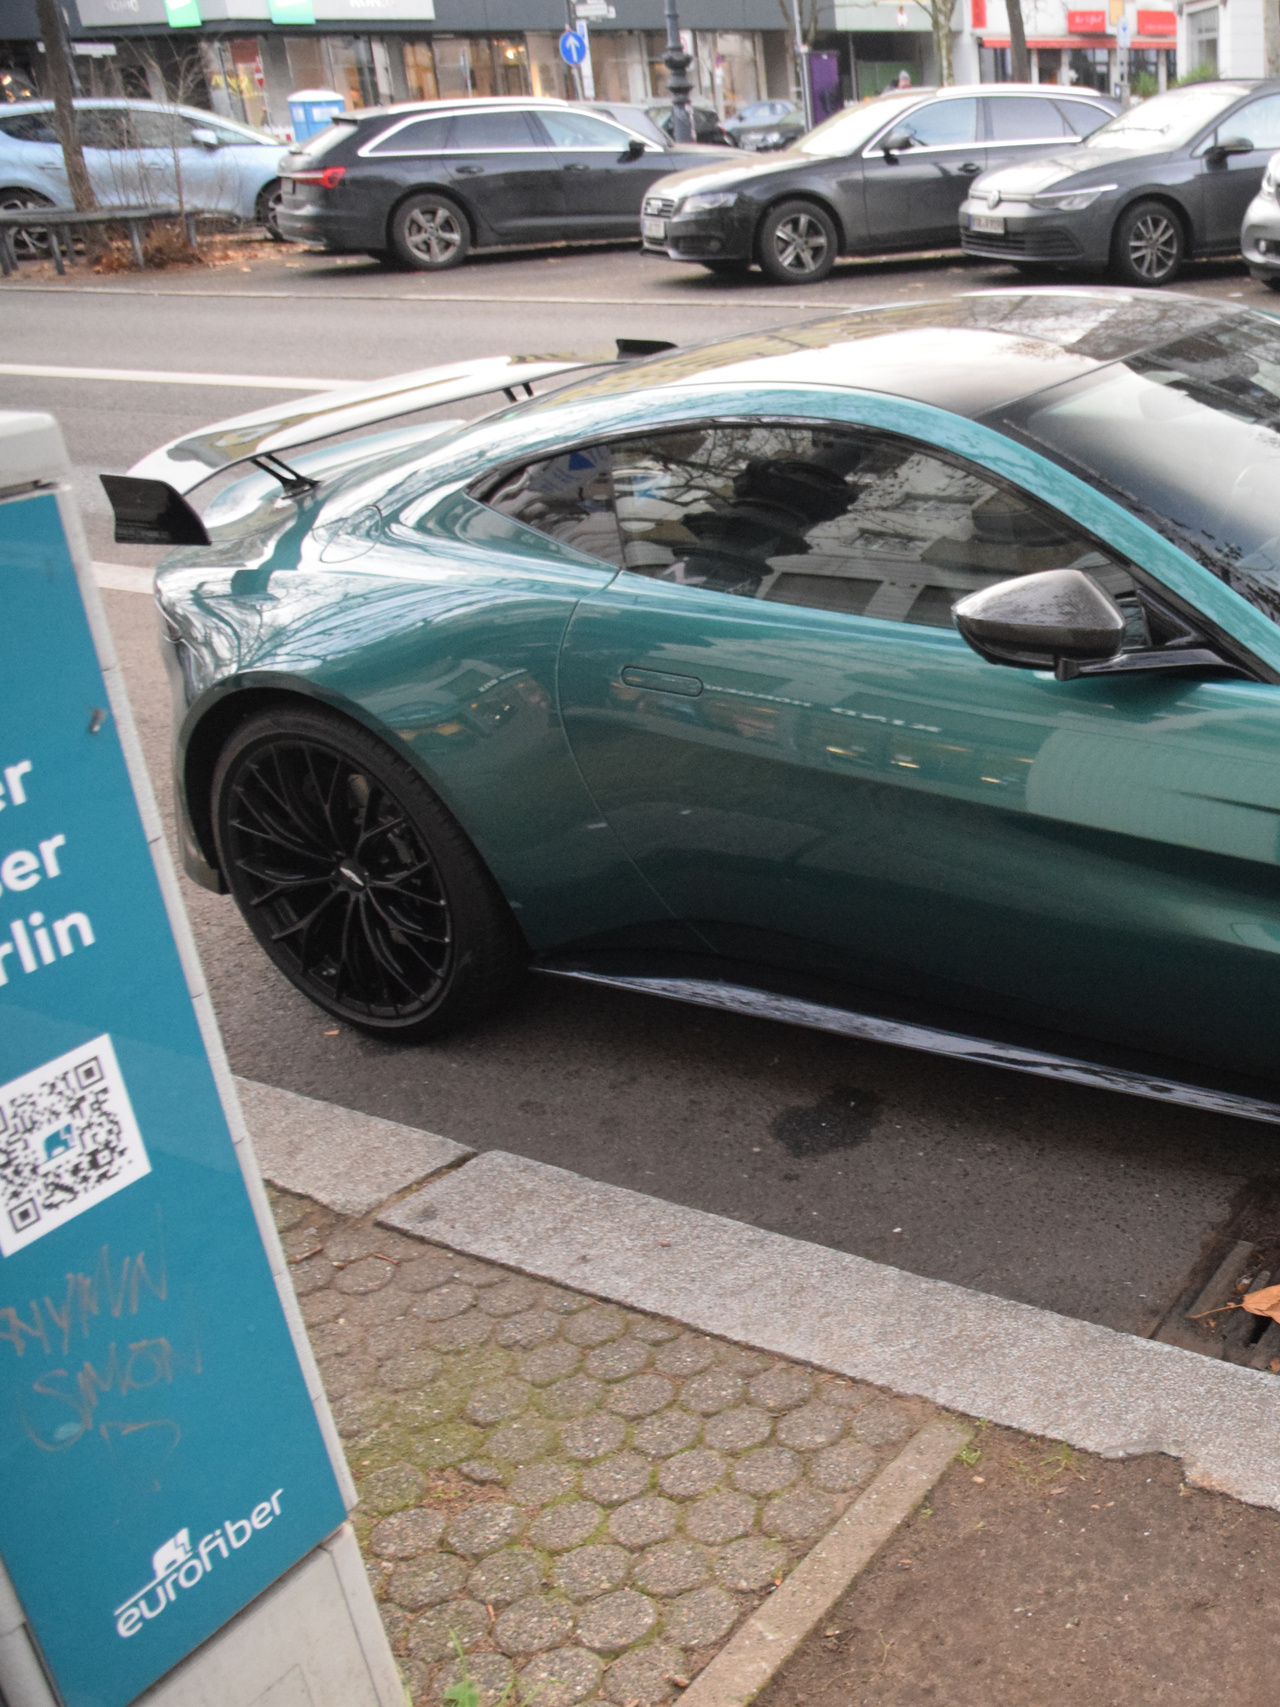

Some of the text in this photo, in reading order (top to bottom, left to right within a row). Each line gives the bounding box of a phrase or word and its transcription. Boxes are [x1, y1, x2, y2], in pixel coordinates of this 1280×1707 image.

[0, 760, 32, 813] r
[0, 834, 66, 898] er
[115, 1488, 284, 1639] eurofiber
